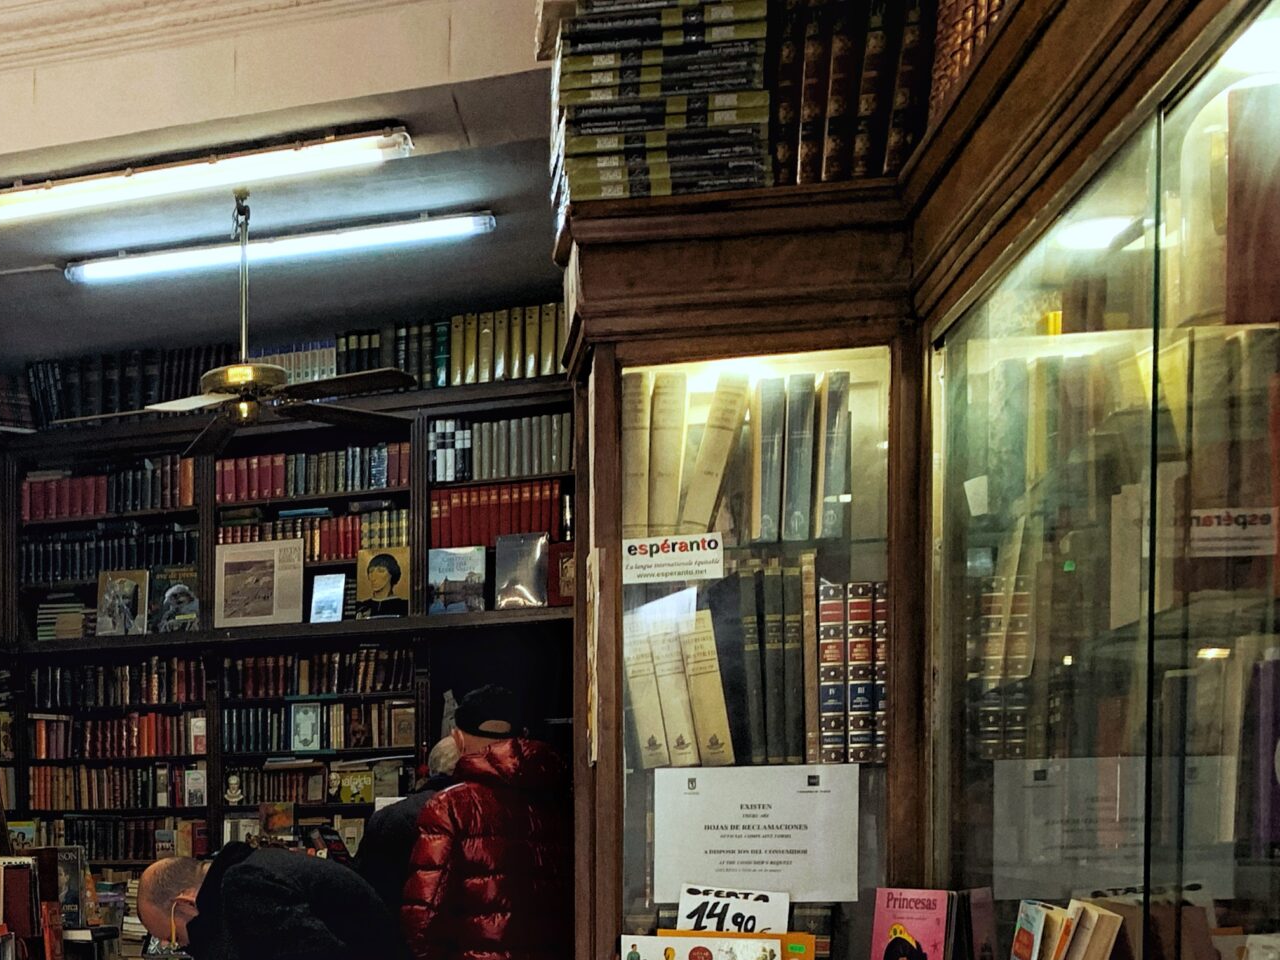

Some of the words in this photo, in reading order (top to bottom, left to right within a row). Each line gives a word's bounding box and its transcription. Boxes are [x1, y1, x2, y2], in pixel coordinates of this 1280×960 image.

[628, 538, 718, 557] espéranto
[637, 569, 707, 579] www.esperanto.net
[740, 803, 772, 811] EXISTEN
[686, 887, 769, 903] OFERTA
[886, 892, 937, 911] Princesas
